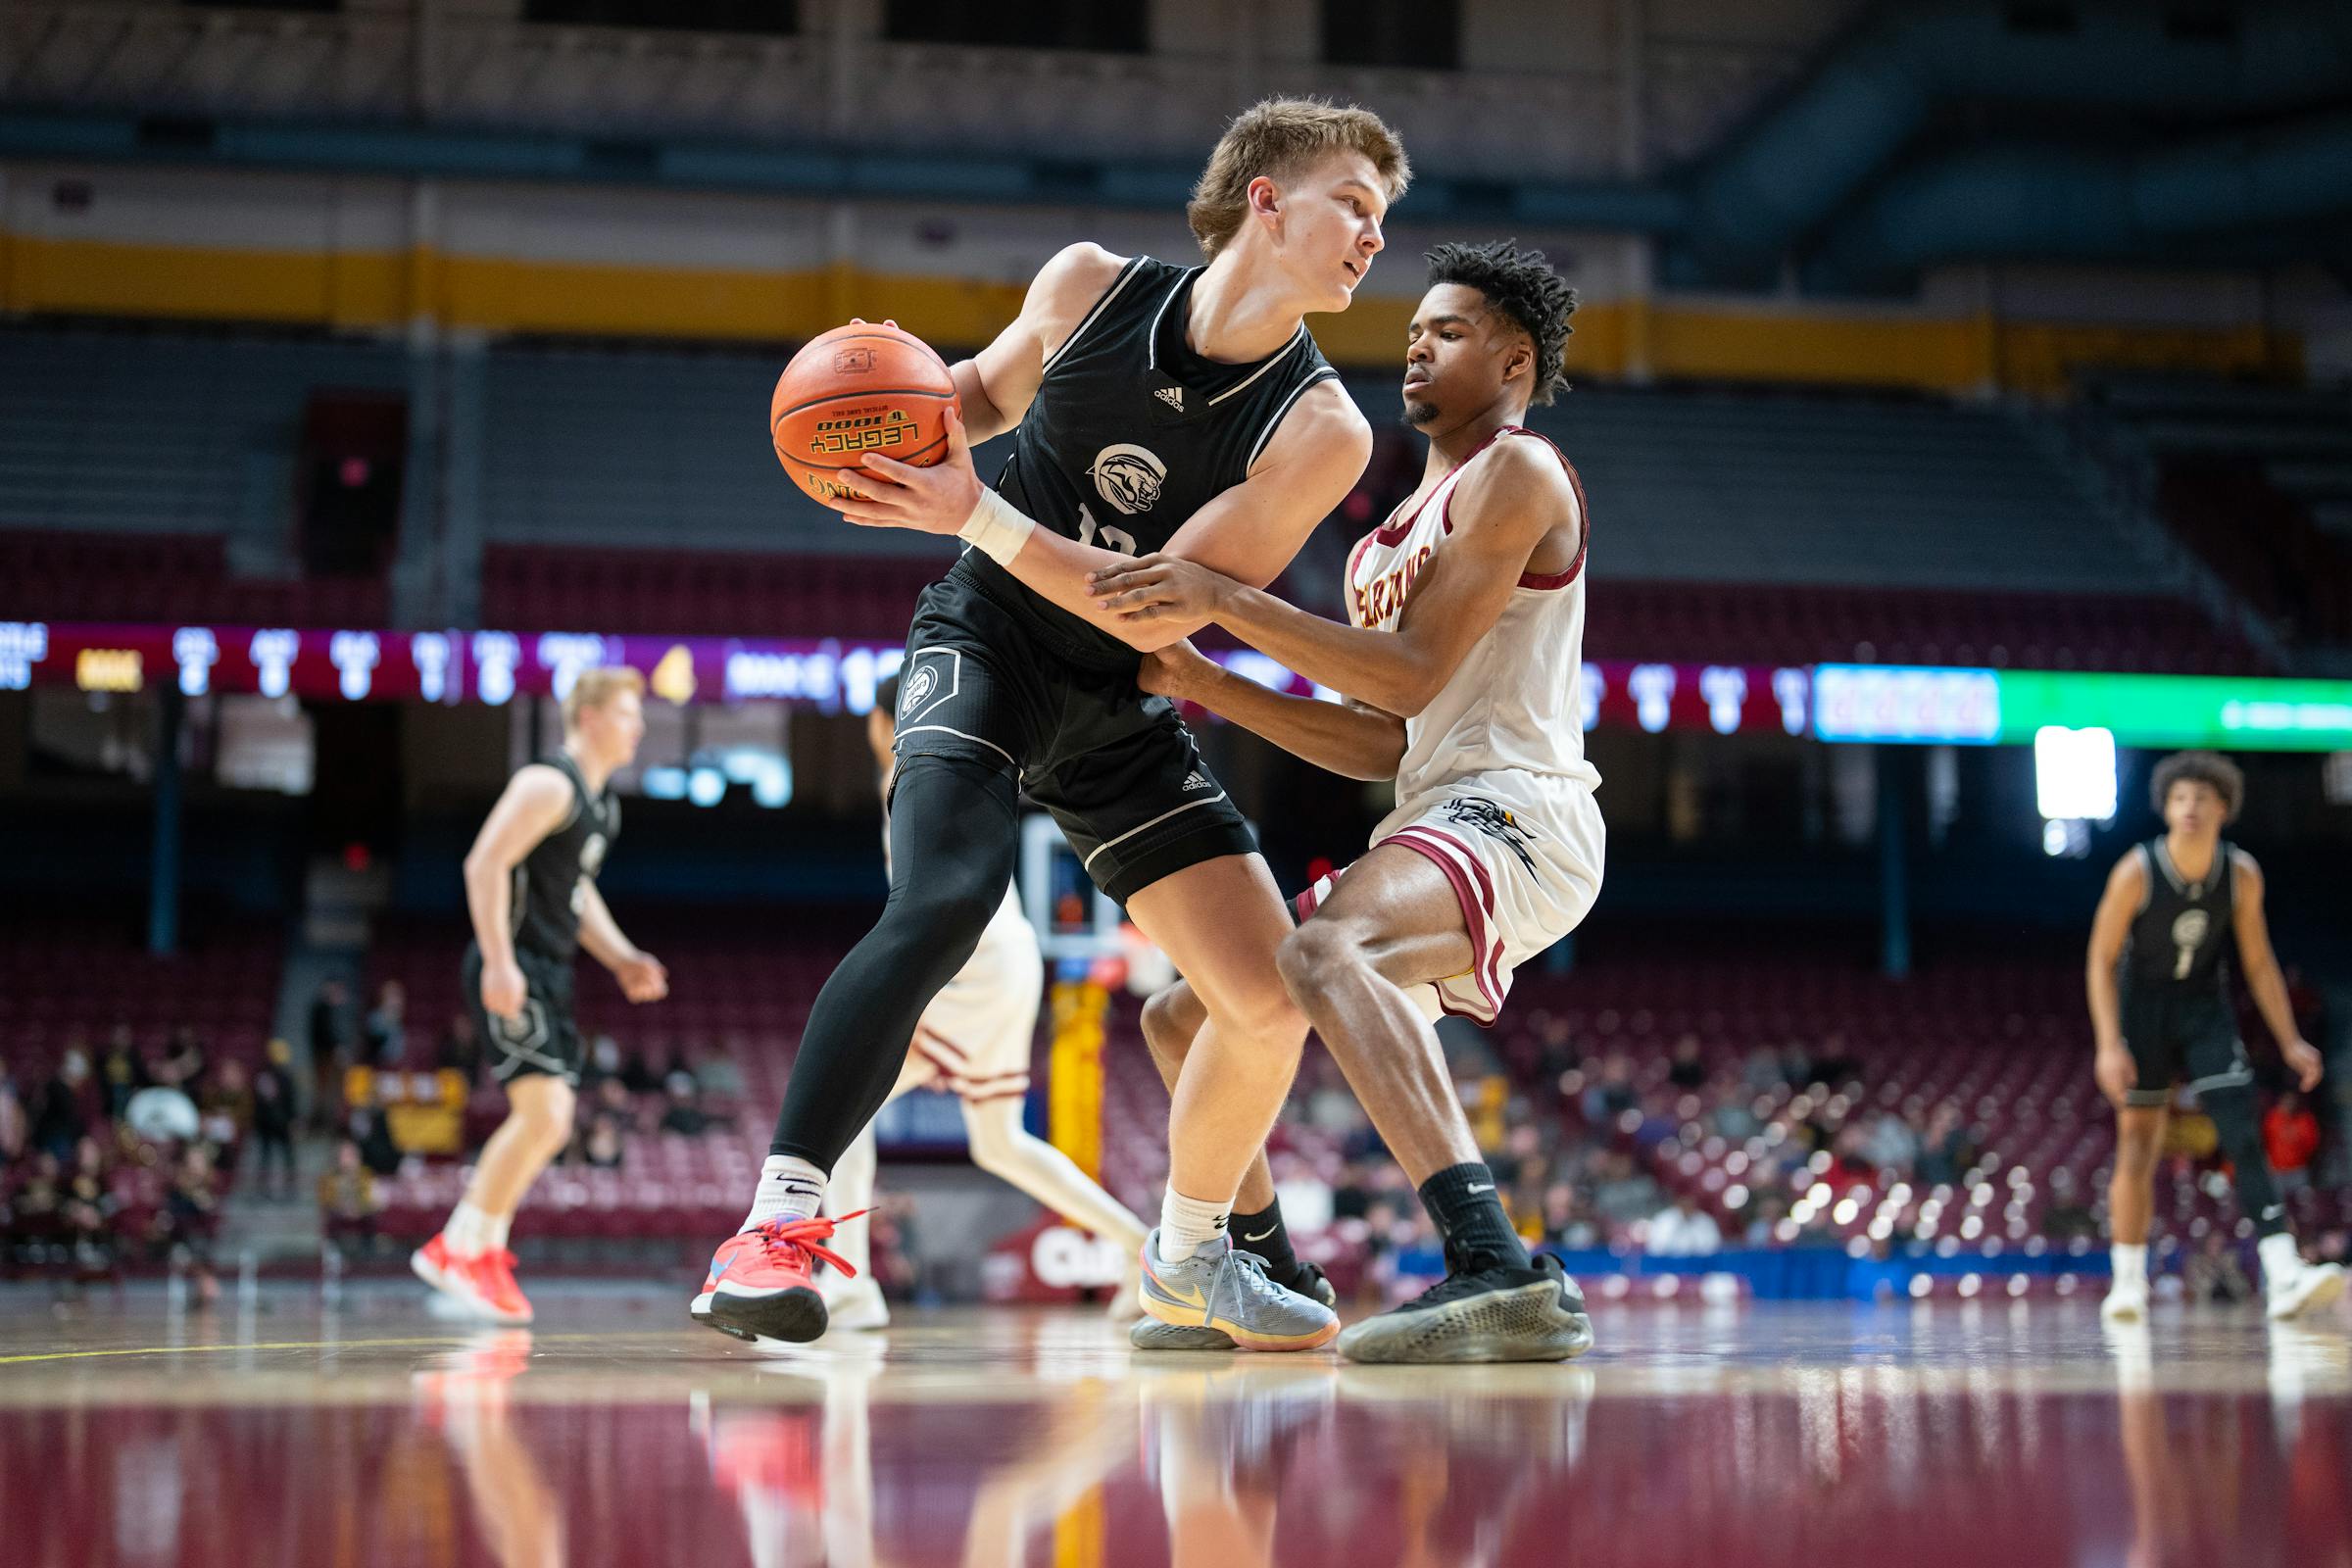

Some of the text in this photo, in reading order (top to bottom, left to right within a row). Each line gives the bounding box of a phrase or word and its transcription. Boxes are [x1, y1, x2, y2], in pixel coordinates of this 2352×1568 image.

[1154, 390, 1185, 413] adidas
[817, 416, 882, 431] 1000
[810, 422, 919, 454] LEGACY
[1182, 782, 1212, 792] adidas
